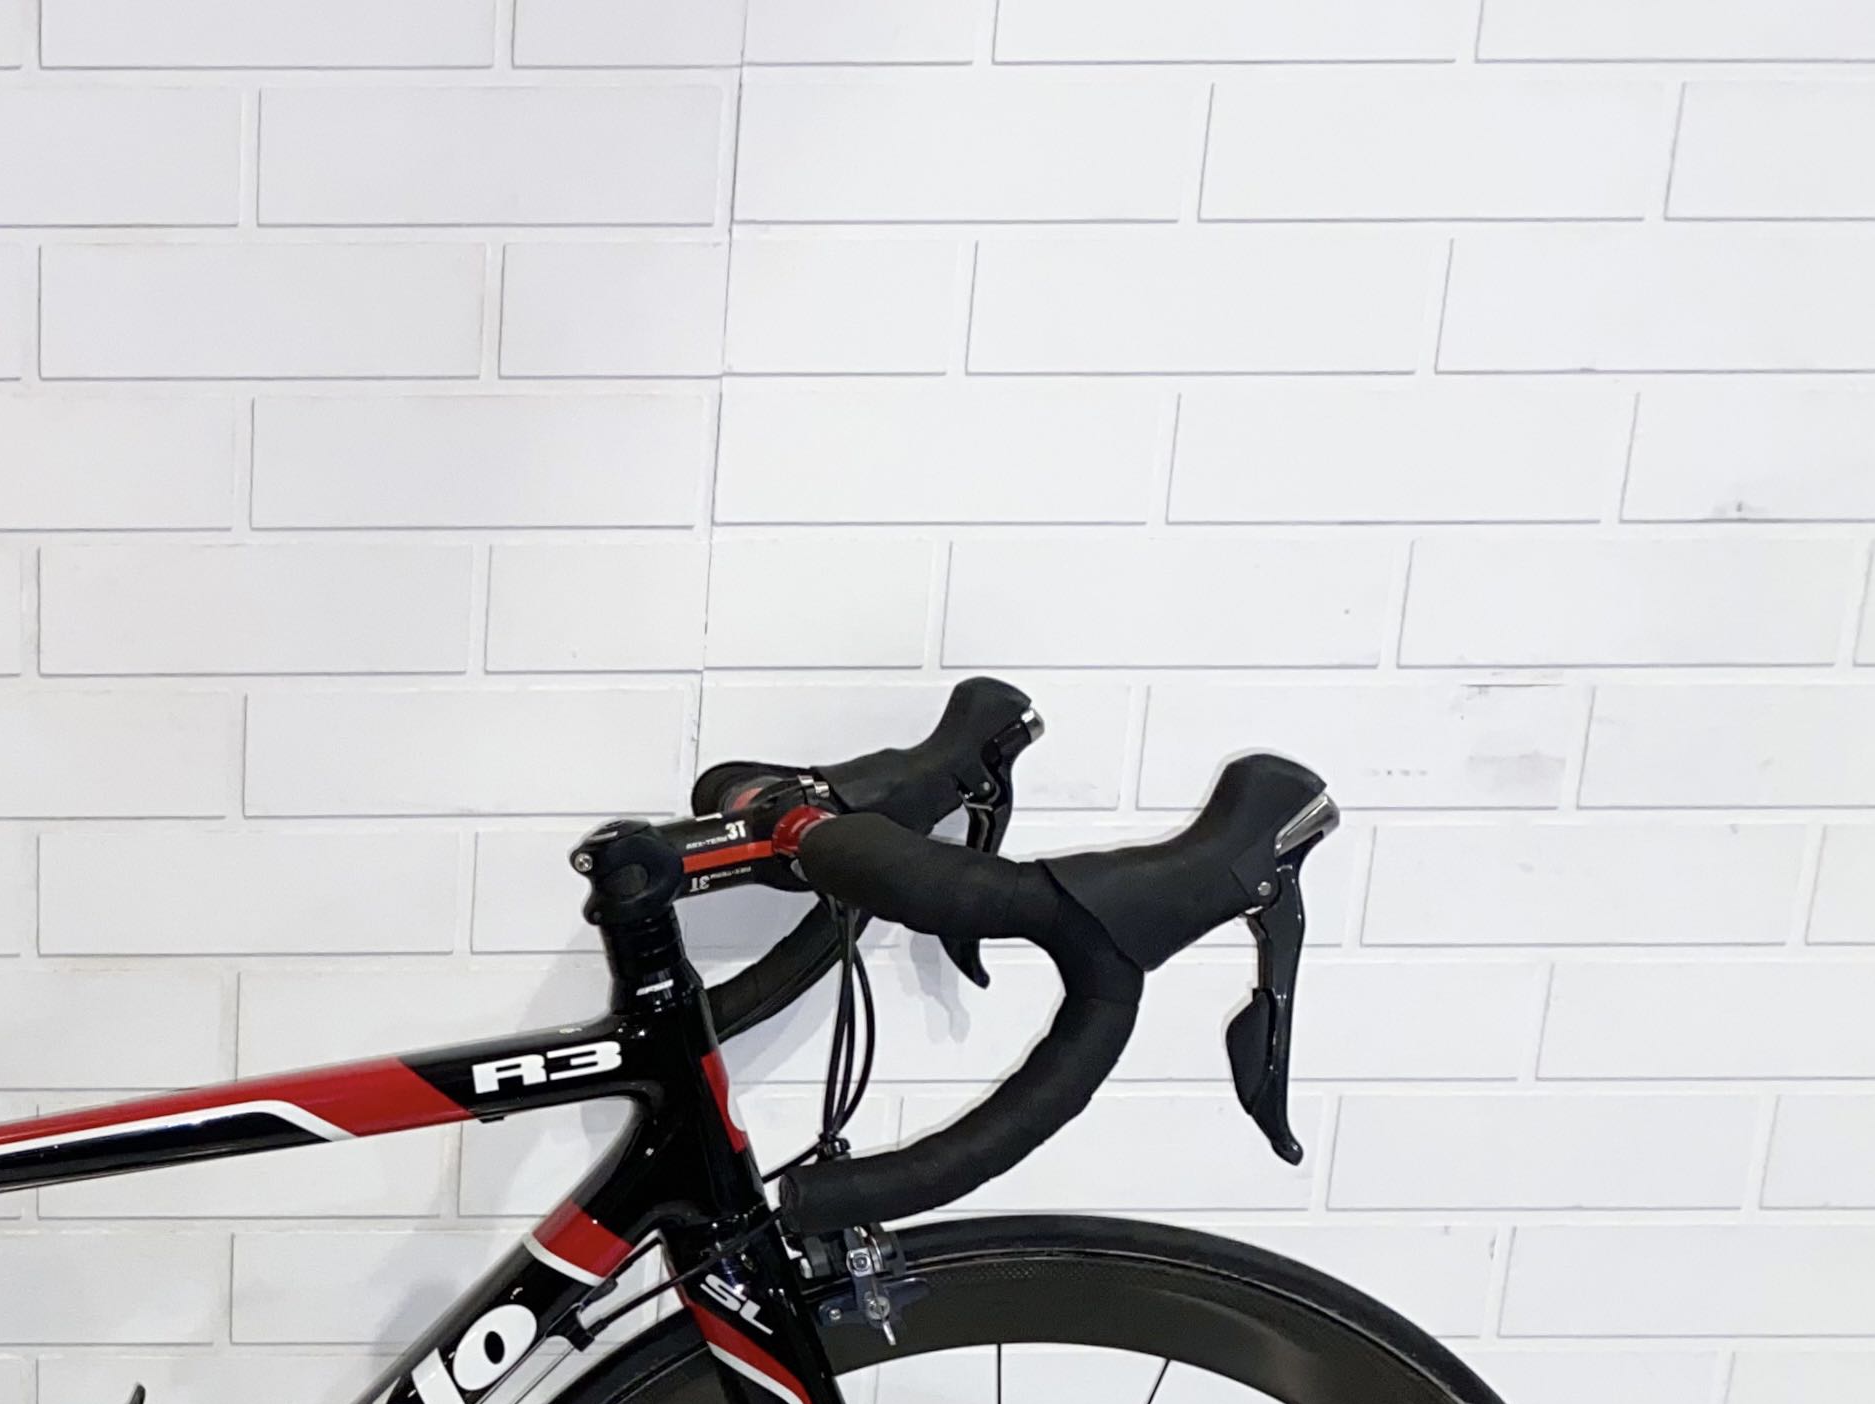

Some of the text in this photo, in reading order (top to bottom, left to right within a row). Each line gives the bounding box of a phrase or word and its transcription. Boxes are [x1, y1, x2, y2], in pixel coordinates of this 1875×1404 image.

[725, 820, 747, 840] 3T
[471, 1040, 622, 1095] R3
[700, 1274, 773, 1335] SL
